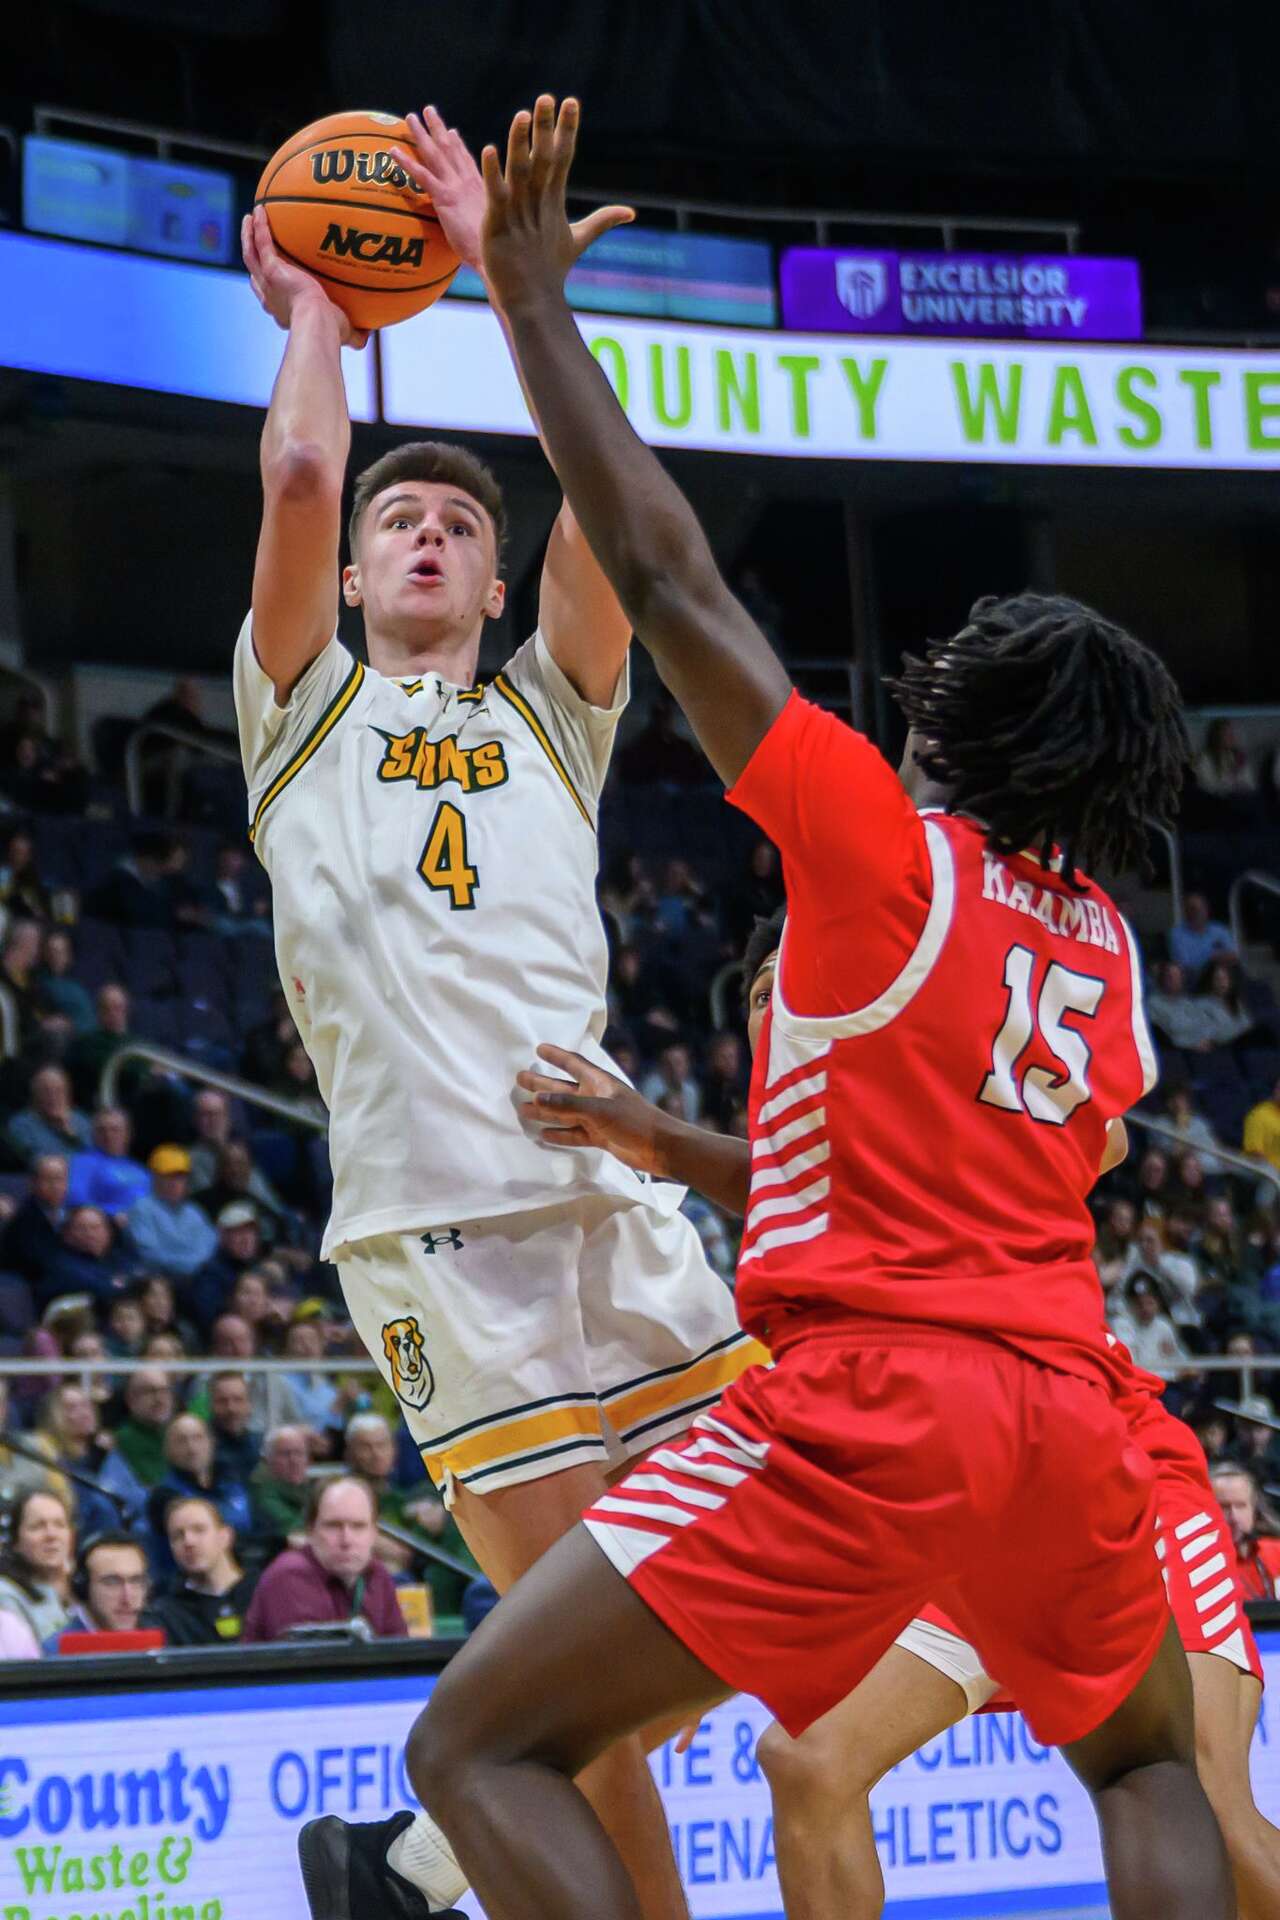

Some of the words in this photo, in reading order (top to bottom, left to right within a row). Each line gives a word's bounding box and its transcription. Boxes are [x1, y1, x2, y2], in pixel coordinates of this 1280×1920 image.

[309, 149, 426, 195] Wils
[320, 223, 425, 267] NCAA
[898, 258, 1069, 297] EXCELSIOR
[900, 293, 1089, 329] UNIVERSITY
[950, 361, 1280, 452] WASTE
[416, 800, 481, 911] 4
[977, 942, 1106, 1127] 15
[0, 1748, 231, 1842] County
